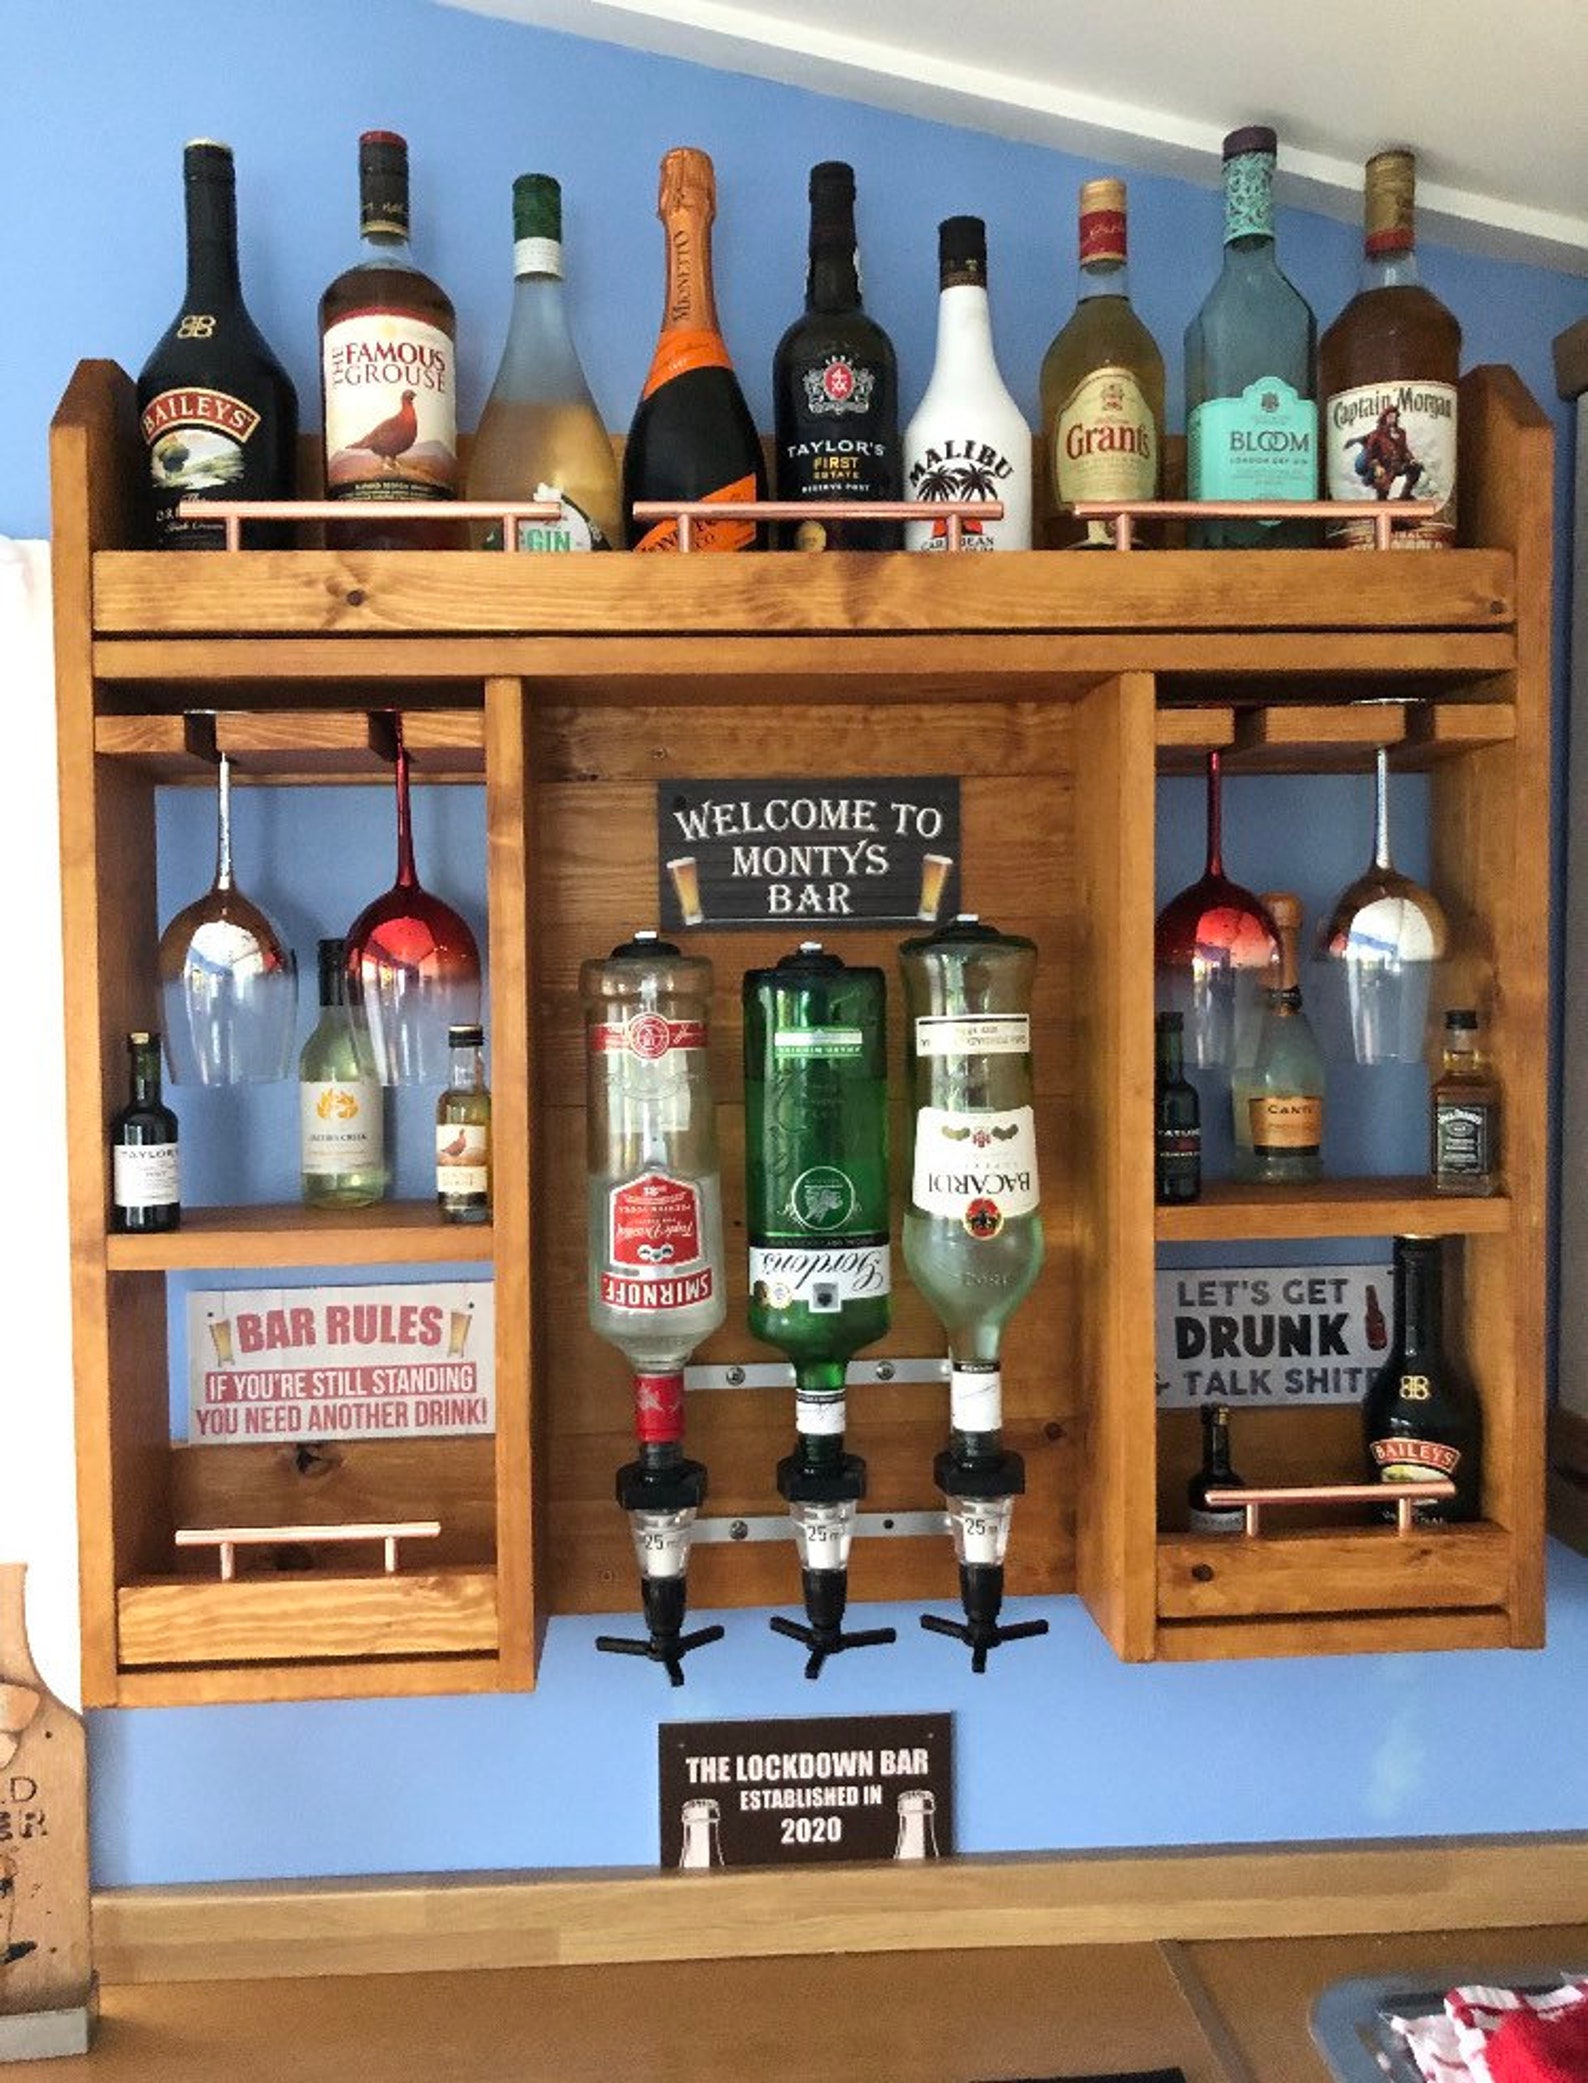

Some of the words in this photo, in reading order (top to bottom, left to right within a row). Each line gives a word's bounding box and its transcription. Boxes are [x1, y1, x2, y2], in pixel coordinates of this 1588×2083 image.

[346, 342, 446, 374] FAMOUS
[345, 363, 445, 393] GROUSE
[144, 396, 248, 431] BAILEYS
[1333, 390, 1391, 429] Captain
[1395, 386, 1452, 419] Morgan
[787, 439, 886, 458] TAYLOR'S
[1230, 430, 1309, 452] BLOOM
[814, 456, 859, 470] FIRST
[909, 439, 1015, 488] MALIBU
[527, 529, 570, 551] GIN
[673, 798, 878, 841] WELCOME
[891, 803, 943, 838] TO
[731, 839, 890, 877] MONTY'S
[768, 882, 853, 914] BAR
[928, 1172, 1030, 1195] BACARDI
[760, 1250, 884, 1292] Gordon's
[605, 1274, 708, 1305] SMIRNOFF
[1178, 1279, 1270, 1307] LET'S
[1282, 1278, 1348, 1305] GET
[236, 1307, 316, 1353] BAR
[326, 1305, 444, 1346] RULES
[1174, 1313, 1350, 1359] DRUNK
[209, 1376, 227, 1400] IF
[234, 1371, 305, 1399] YOU'RE
[312, 1369, 368, 1397] STILL
[372, 1365, 474, 1394] STANDING
[1183, 1368, 1272, 1395] TALK
[196, 1408, 238, 1435] YOU
[245, 1405, 301, 1434] NEED
[308, 1401, 408, 1431] ANOTHER
[415, 1398, 488, 1428] DRINK!
[1375, 1441, 1454, 1465] BAILEYS
[807, 1525, 826, 1541] 25
[965, 1517, 985, 1535] 25
[645, 1534, 663, 1550] 25
[686, 1756, 731, 1783] THE
[736, 1751, 873, 1781] LOCKDOWN
[880, 1749, 929, 1775] BAR
[740, 1786, 858, 1811] ESTABLISHED
[863, 1785, 883, 1805] IN
[780, 1817, 842, 1844] 2020
